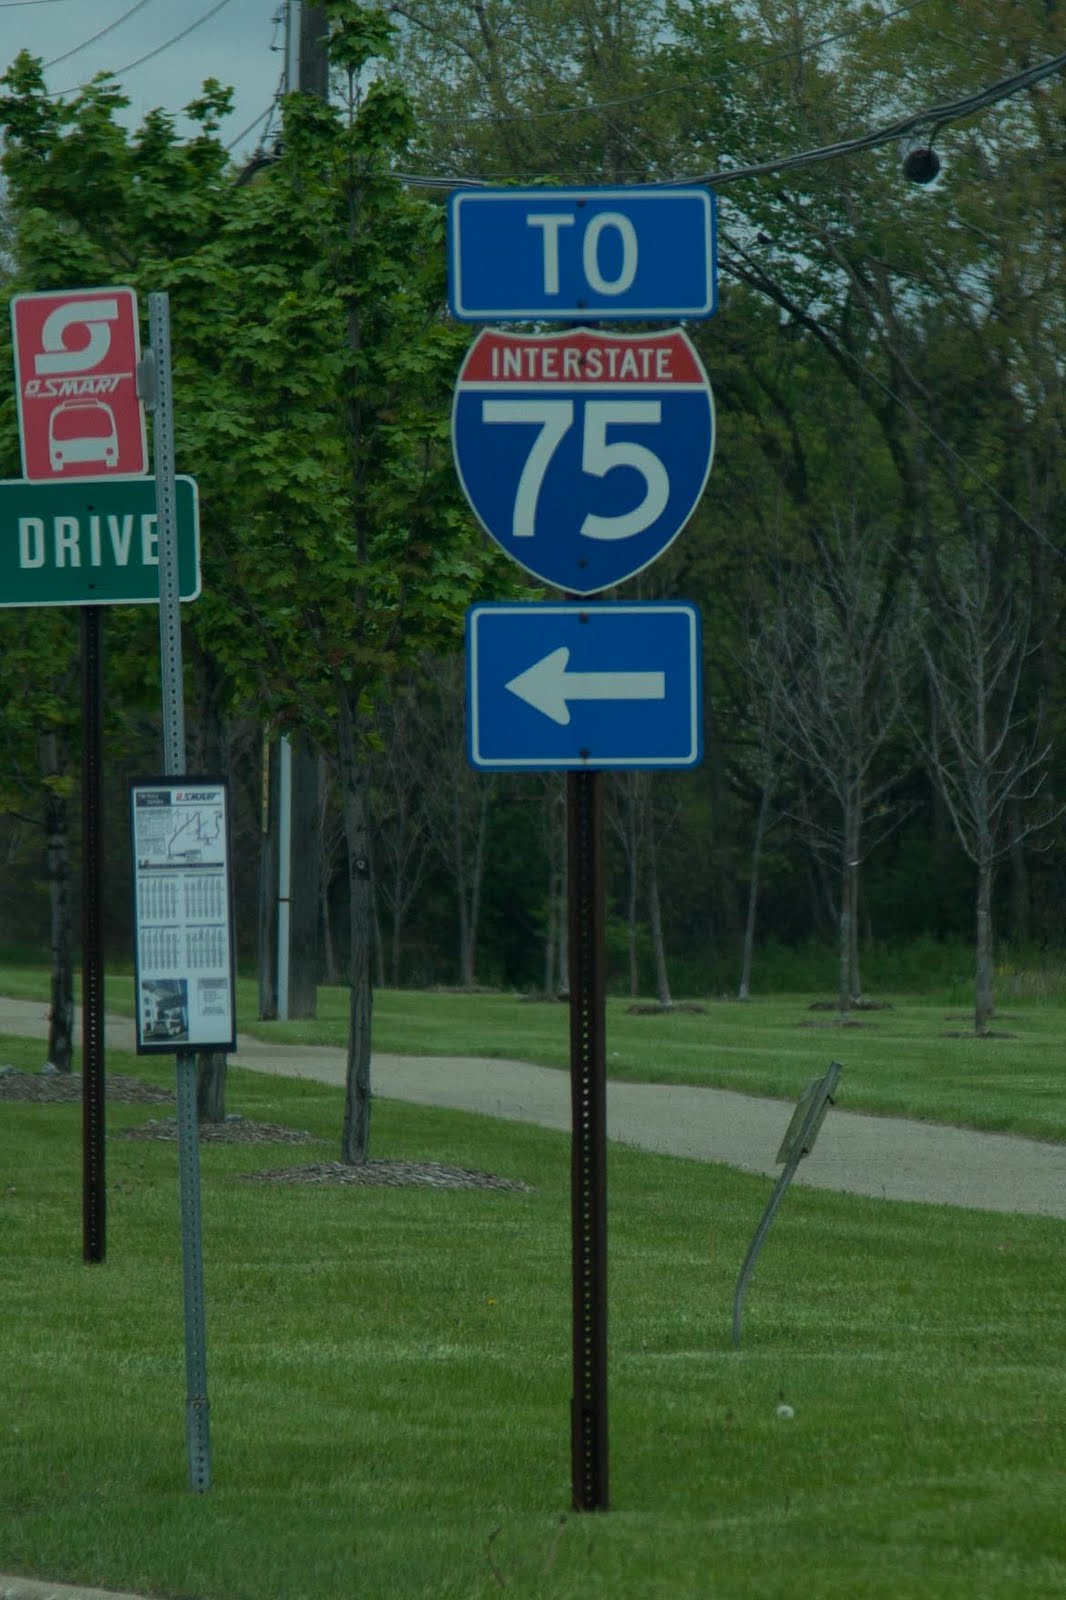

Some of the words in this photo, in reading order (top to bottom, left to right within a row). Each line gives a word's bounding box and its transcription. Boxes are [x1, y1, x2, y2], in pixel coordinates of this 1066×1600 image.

[526, 212, 638, 295] TO
[37, 373, 133, 397] SMART
[491, 346, 673, 379] INTERSTATE
[482, 400, 670, 541] 75
[18, 514, 159, 568] DRIVE
